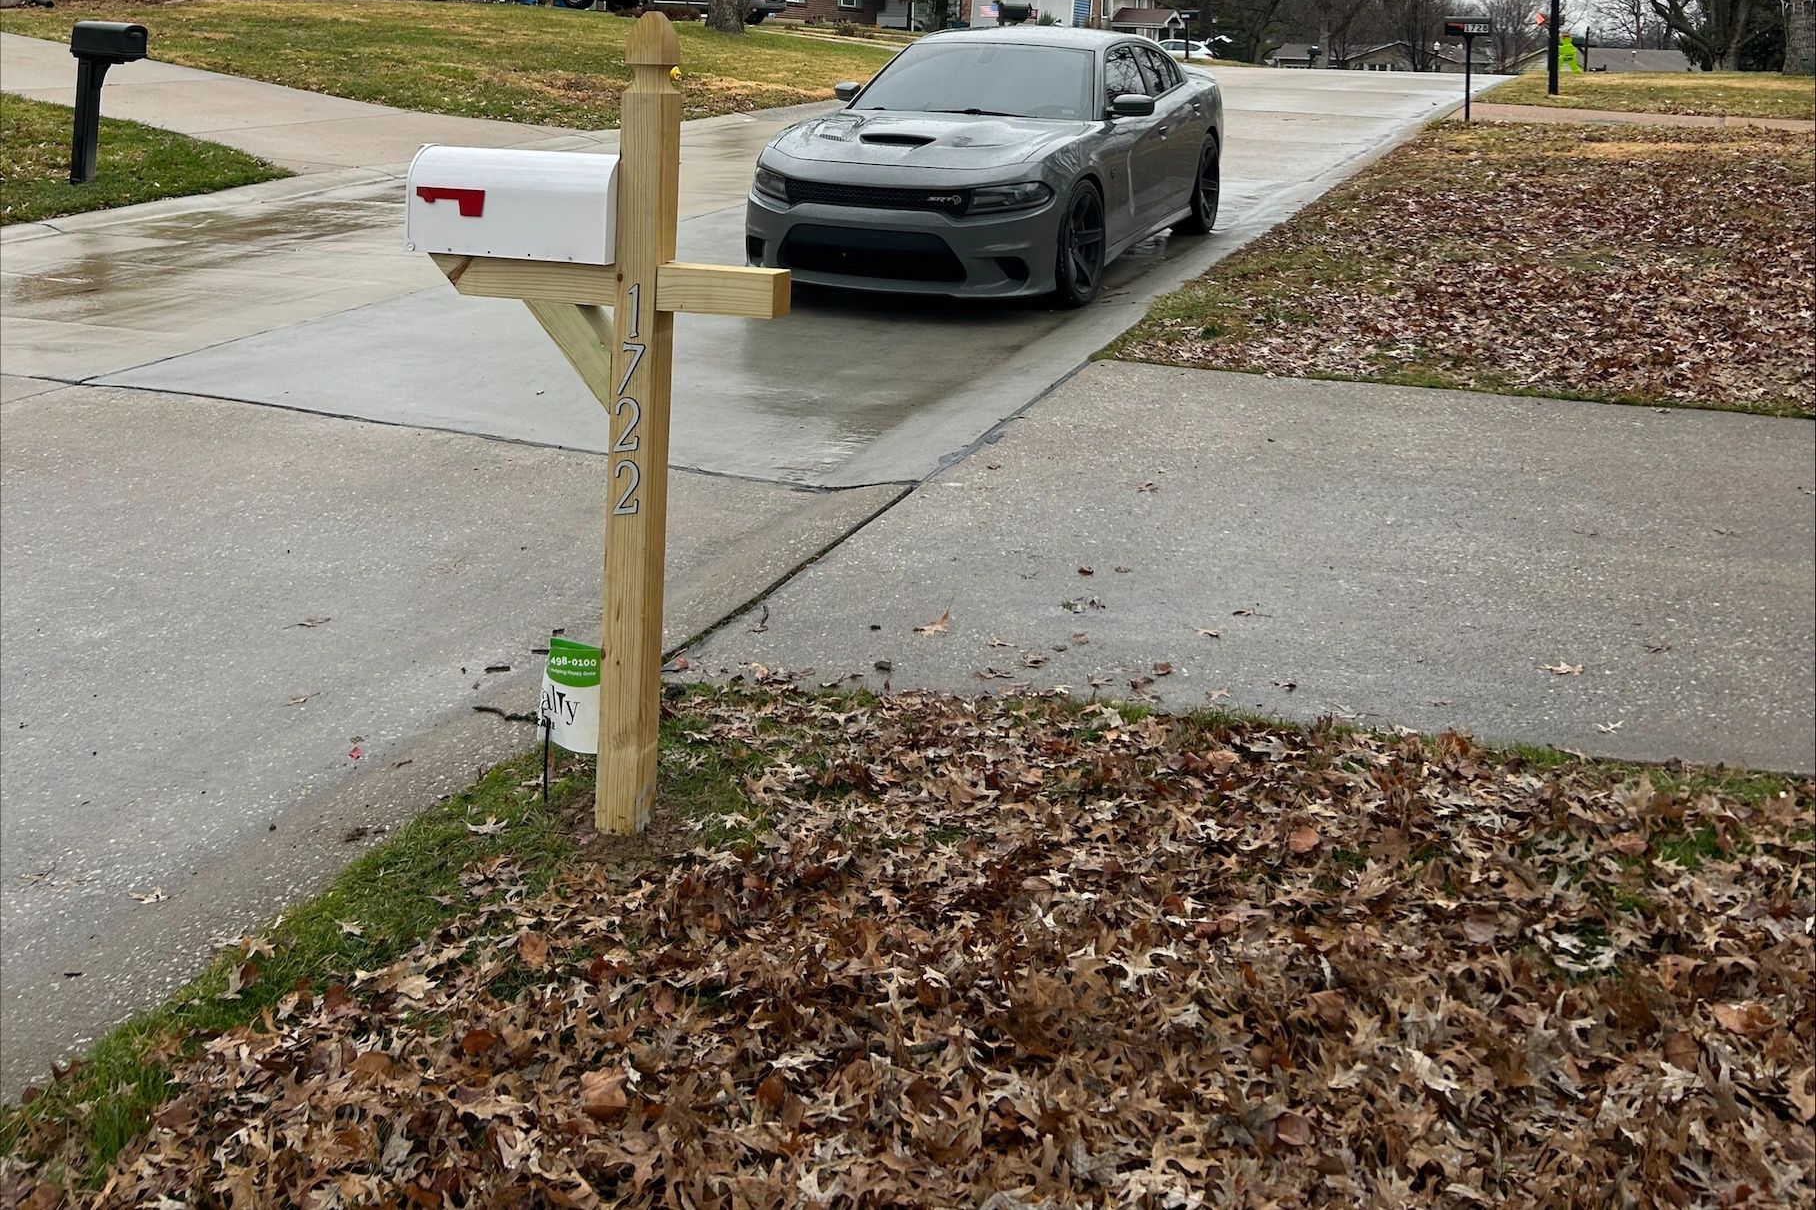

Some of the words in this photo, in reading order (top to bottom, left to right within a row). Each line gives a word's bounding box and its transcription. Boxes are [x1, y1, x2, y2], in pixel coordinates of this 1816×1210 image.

[1465, 24, 1489, 32] 1728
[613, 283, 646, 515] 1722
[550, 656, 597, 667] 498-0100
